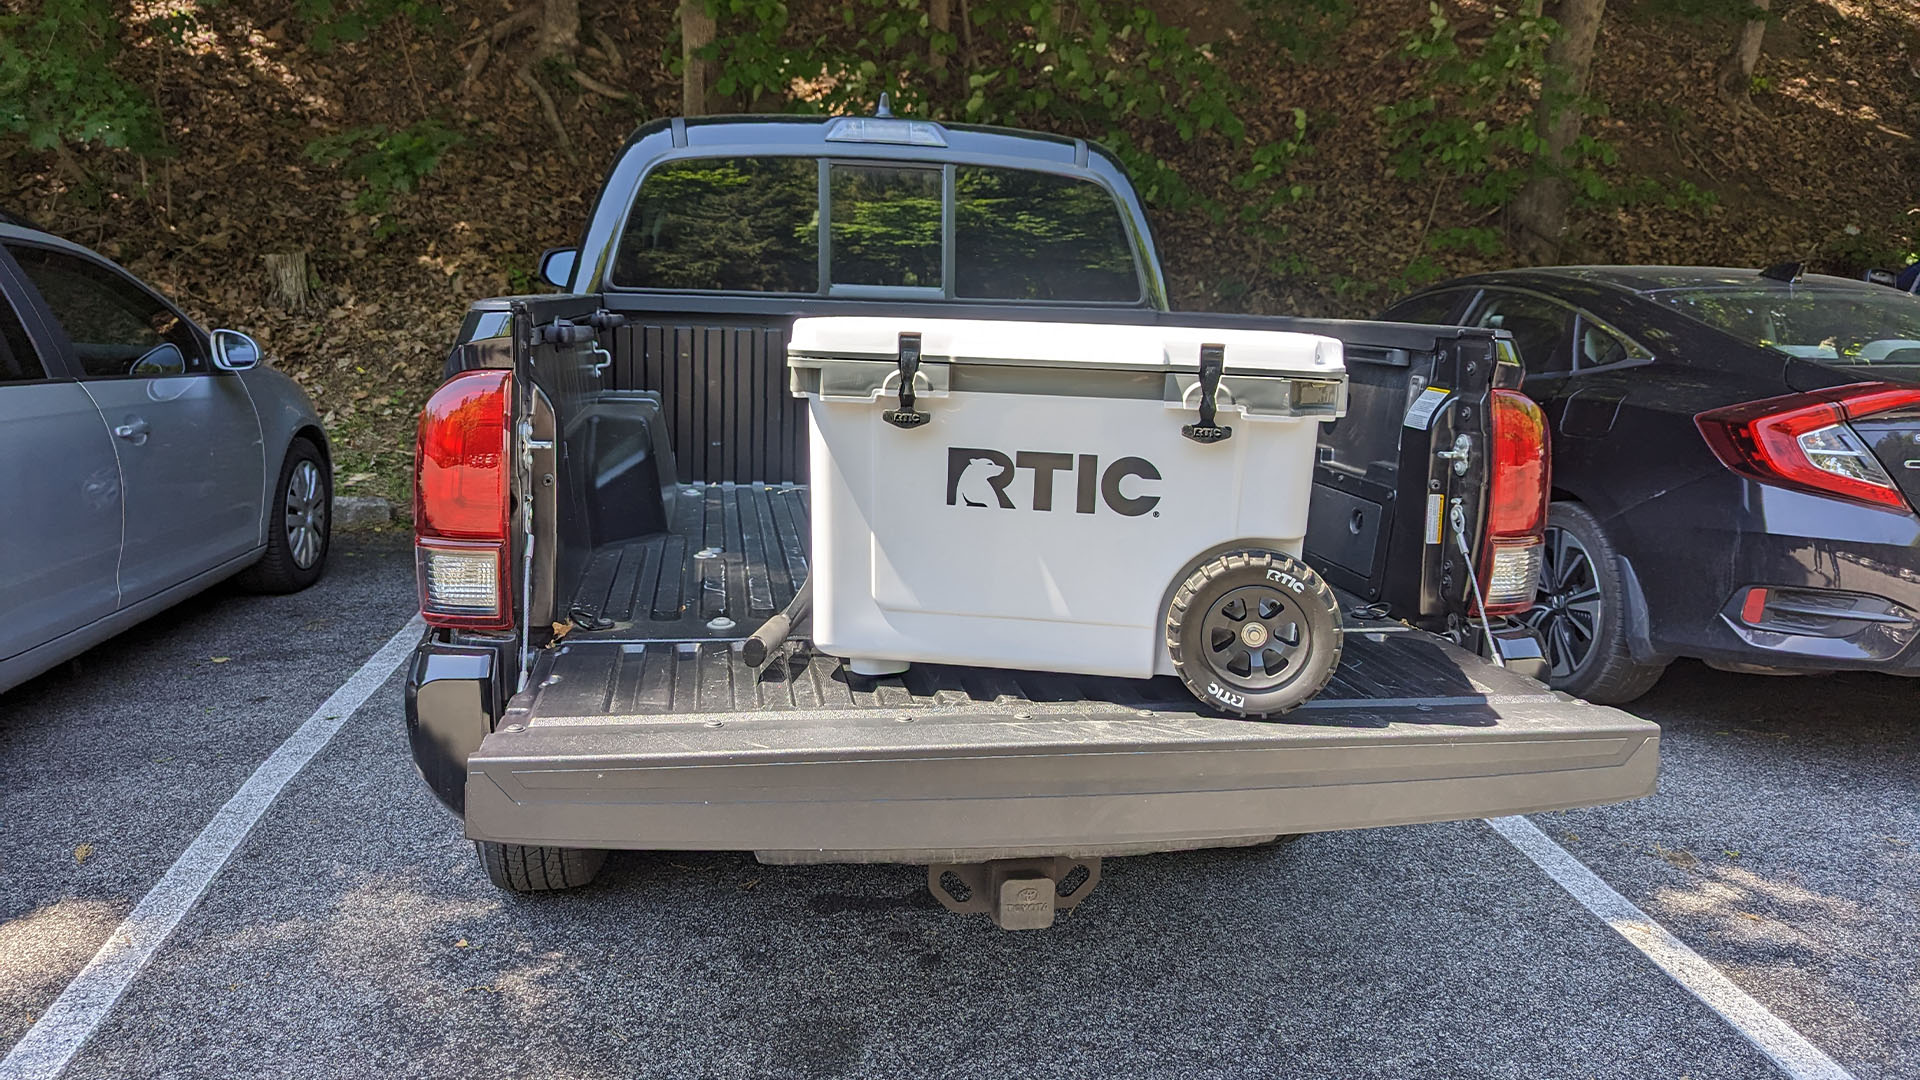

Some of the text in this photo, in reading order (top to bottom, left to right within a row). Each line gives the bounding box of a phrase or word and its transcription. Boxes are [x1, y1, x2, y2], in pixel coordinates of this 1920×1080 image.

[893, 412, 921, 423] RTIC
[1193, 427, 1222, 438] RTIC
[946, 447, 1162, 517] RTIC
[1266, 569, 1305, 593] RTIC
[1207, 682, 1245, 708] RTIC
[1006, 902, 1049, 912] TOYOTA
